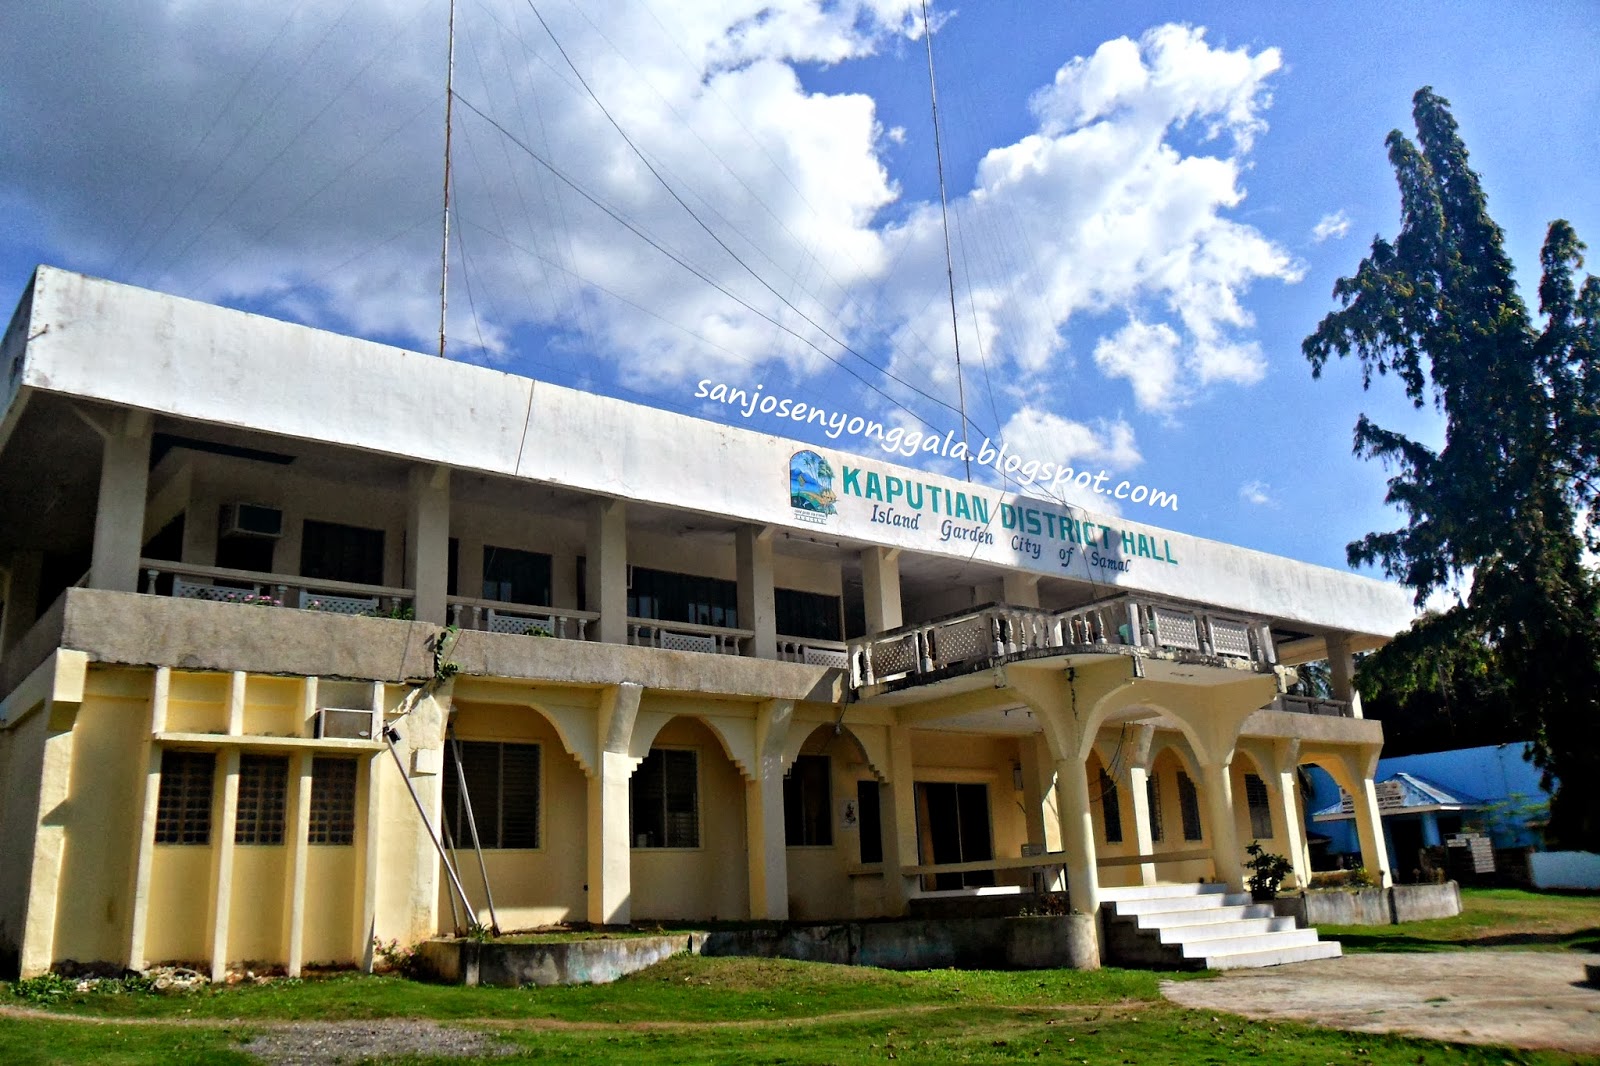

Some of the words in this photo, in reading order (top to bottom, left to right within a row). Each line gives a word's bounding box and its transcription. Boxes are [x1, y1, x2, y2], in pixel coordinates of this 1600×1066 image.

[842, 465, 989, 524] KAPUTIAN
[1001, 503, 1110, 549] DISTRICT
[1121, 530, 1178, 565] HALL
[871, 504, 921, 530] Island
[940, 519, 993, 545] Garden
[1011, 535, 1041, 560] City
[1059, 547, 1074, 567] of
[1091, 551, 1131, 572] Samal
